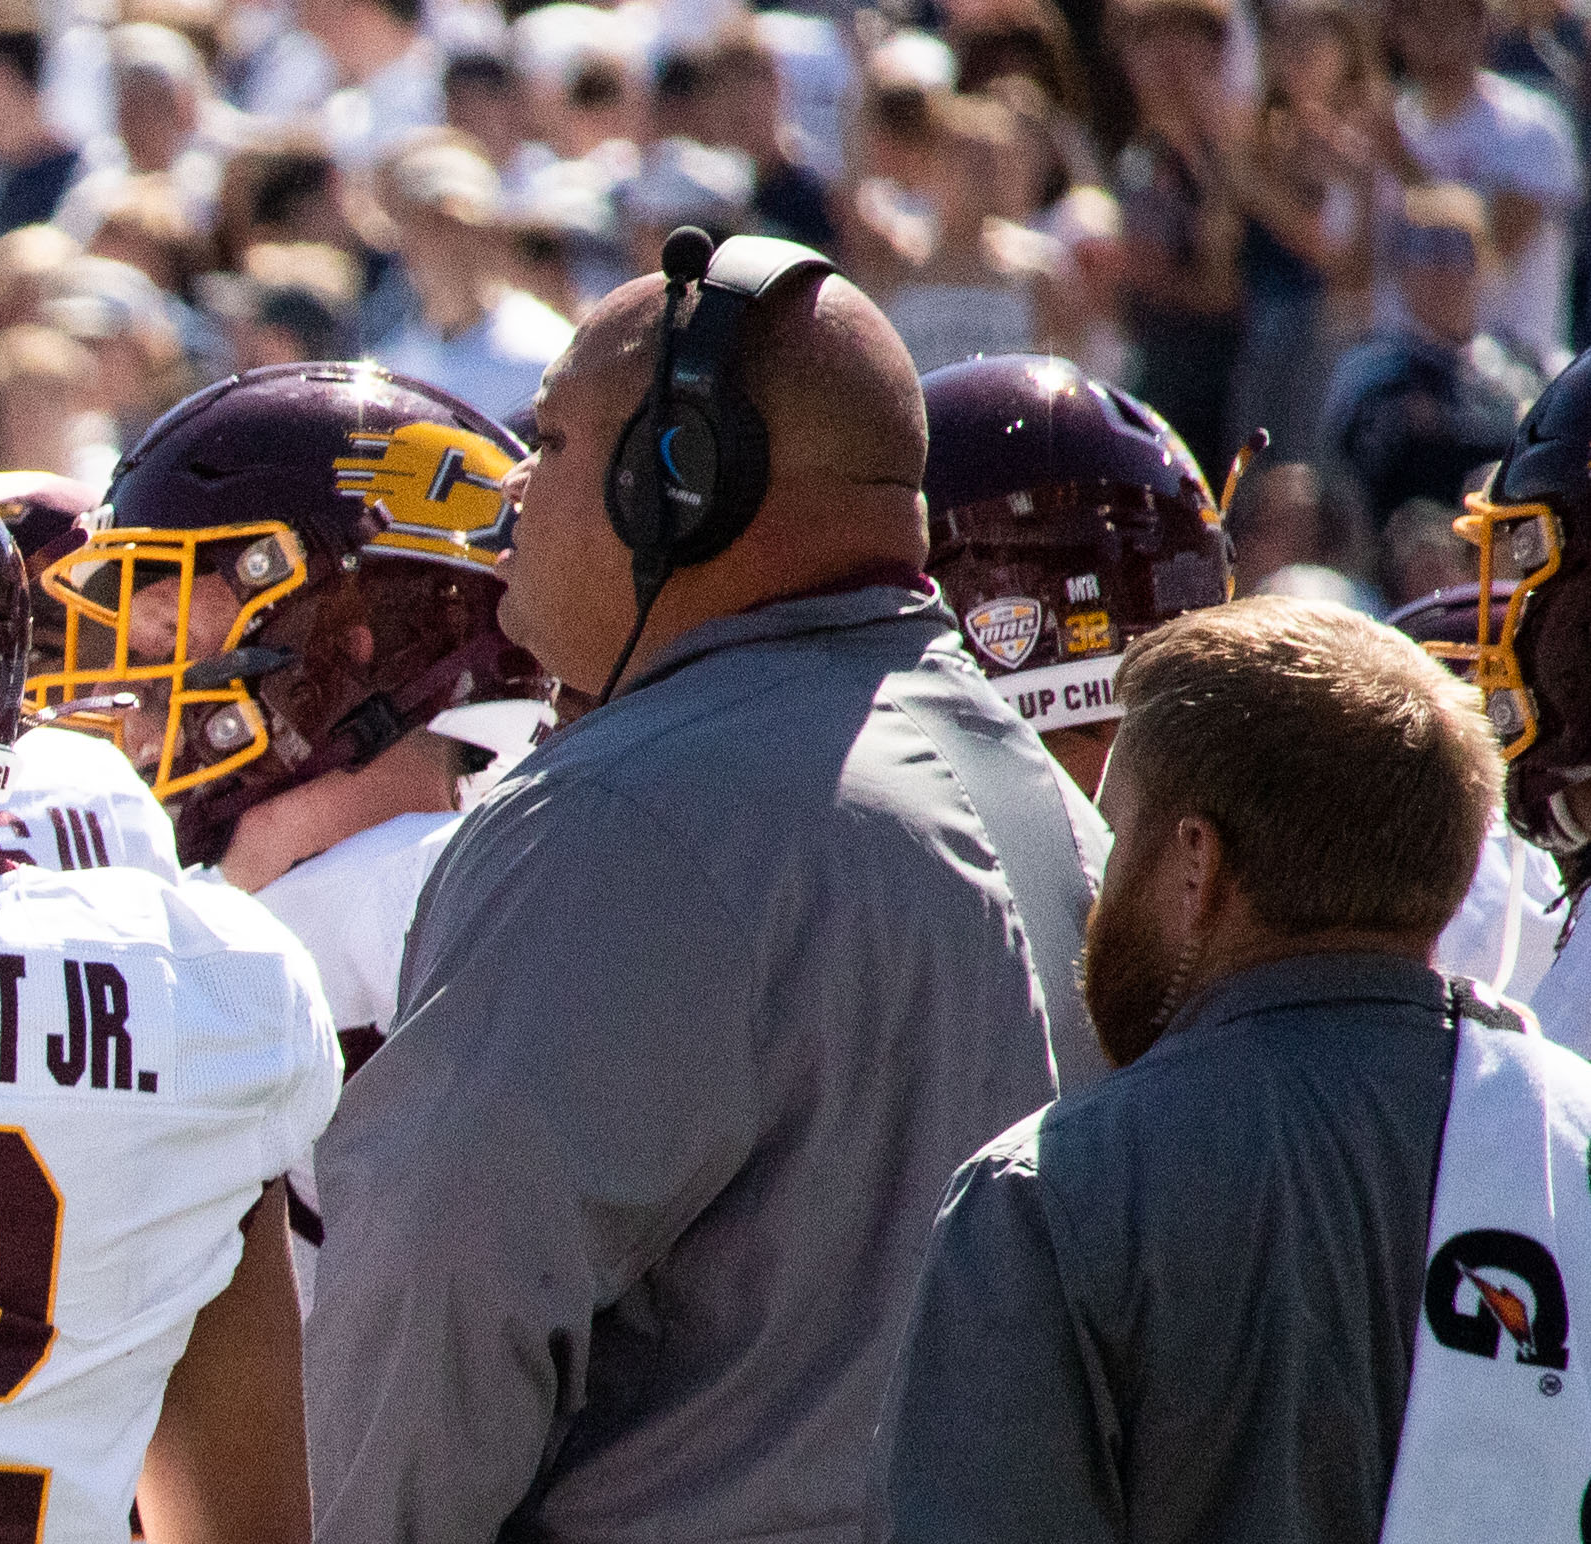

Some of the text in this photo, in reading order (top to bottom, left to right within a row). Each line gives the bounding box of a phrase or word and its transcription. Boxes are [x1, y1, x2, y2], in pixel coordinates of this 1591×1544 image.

[977, 617, 1038, 645] MAC
[1064, 609, 1111, 653] 32
[1018, 689, 1057, 719] UP
[47, 959, 159, 1093] JR.
